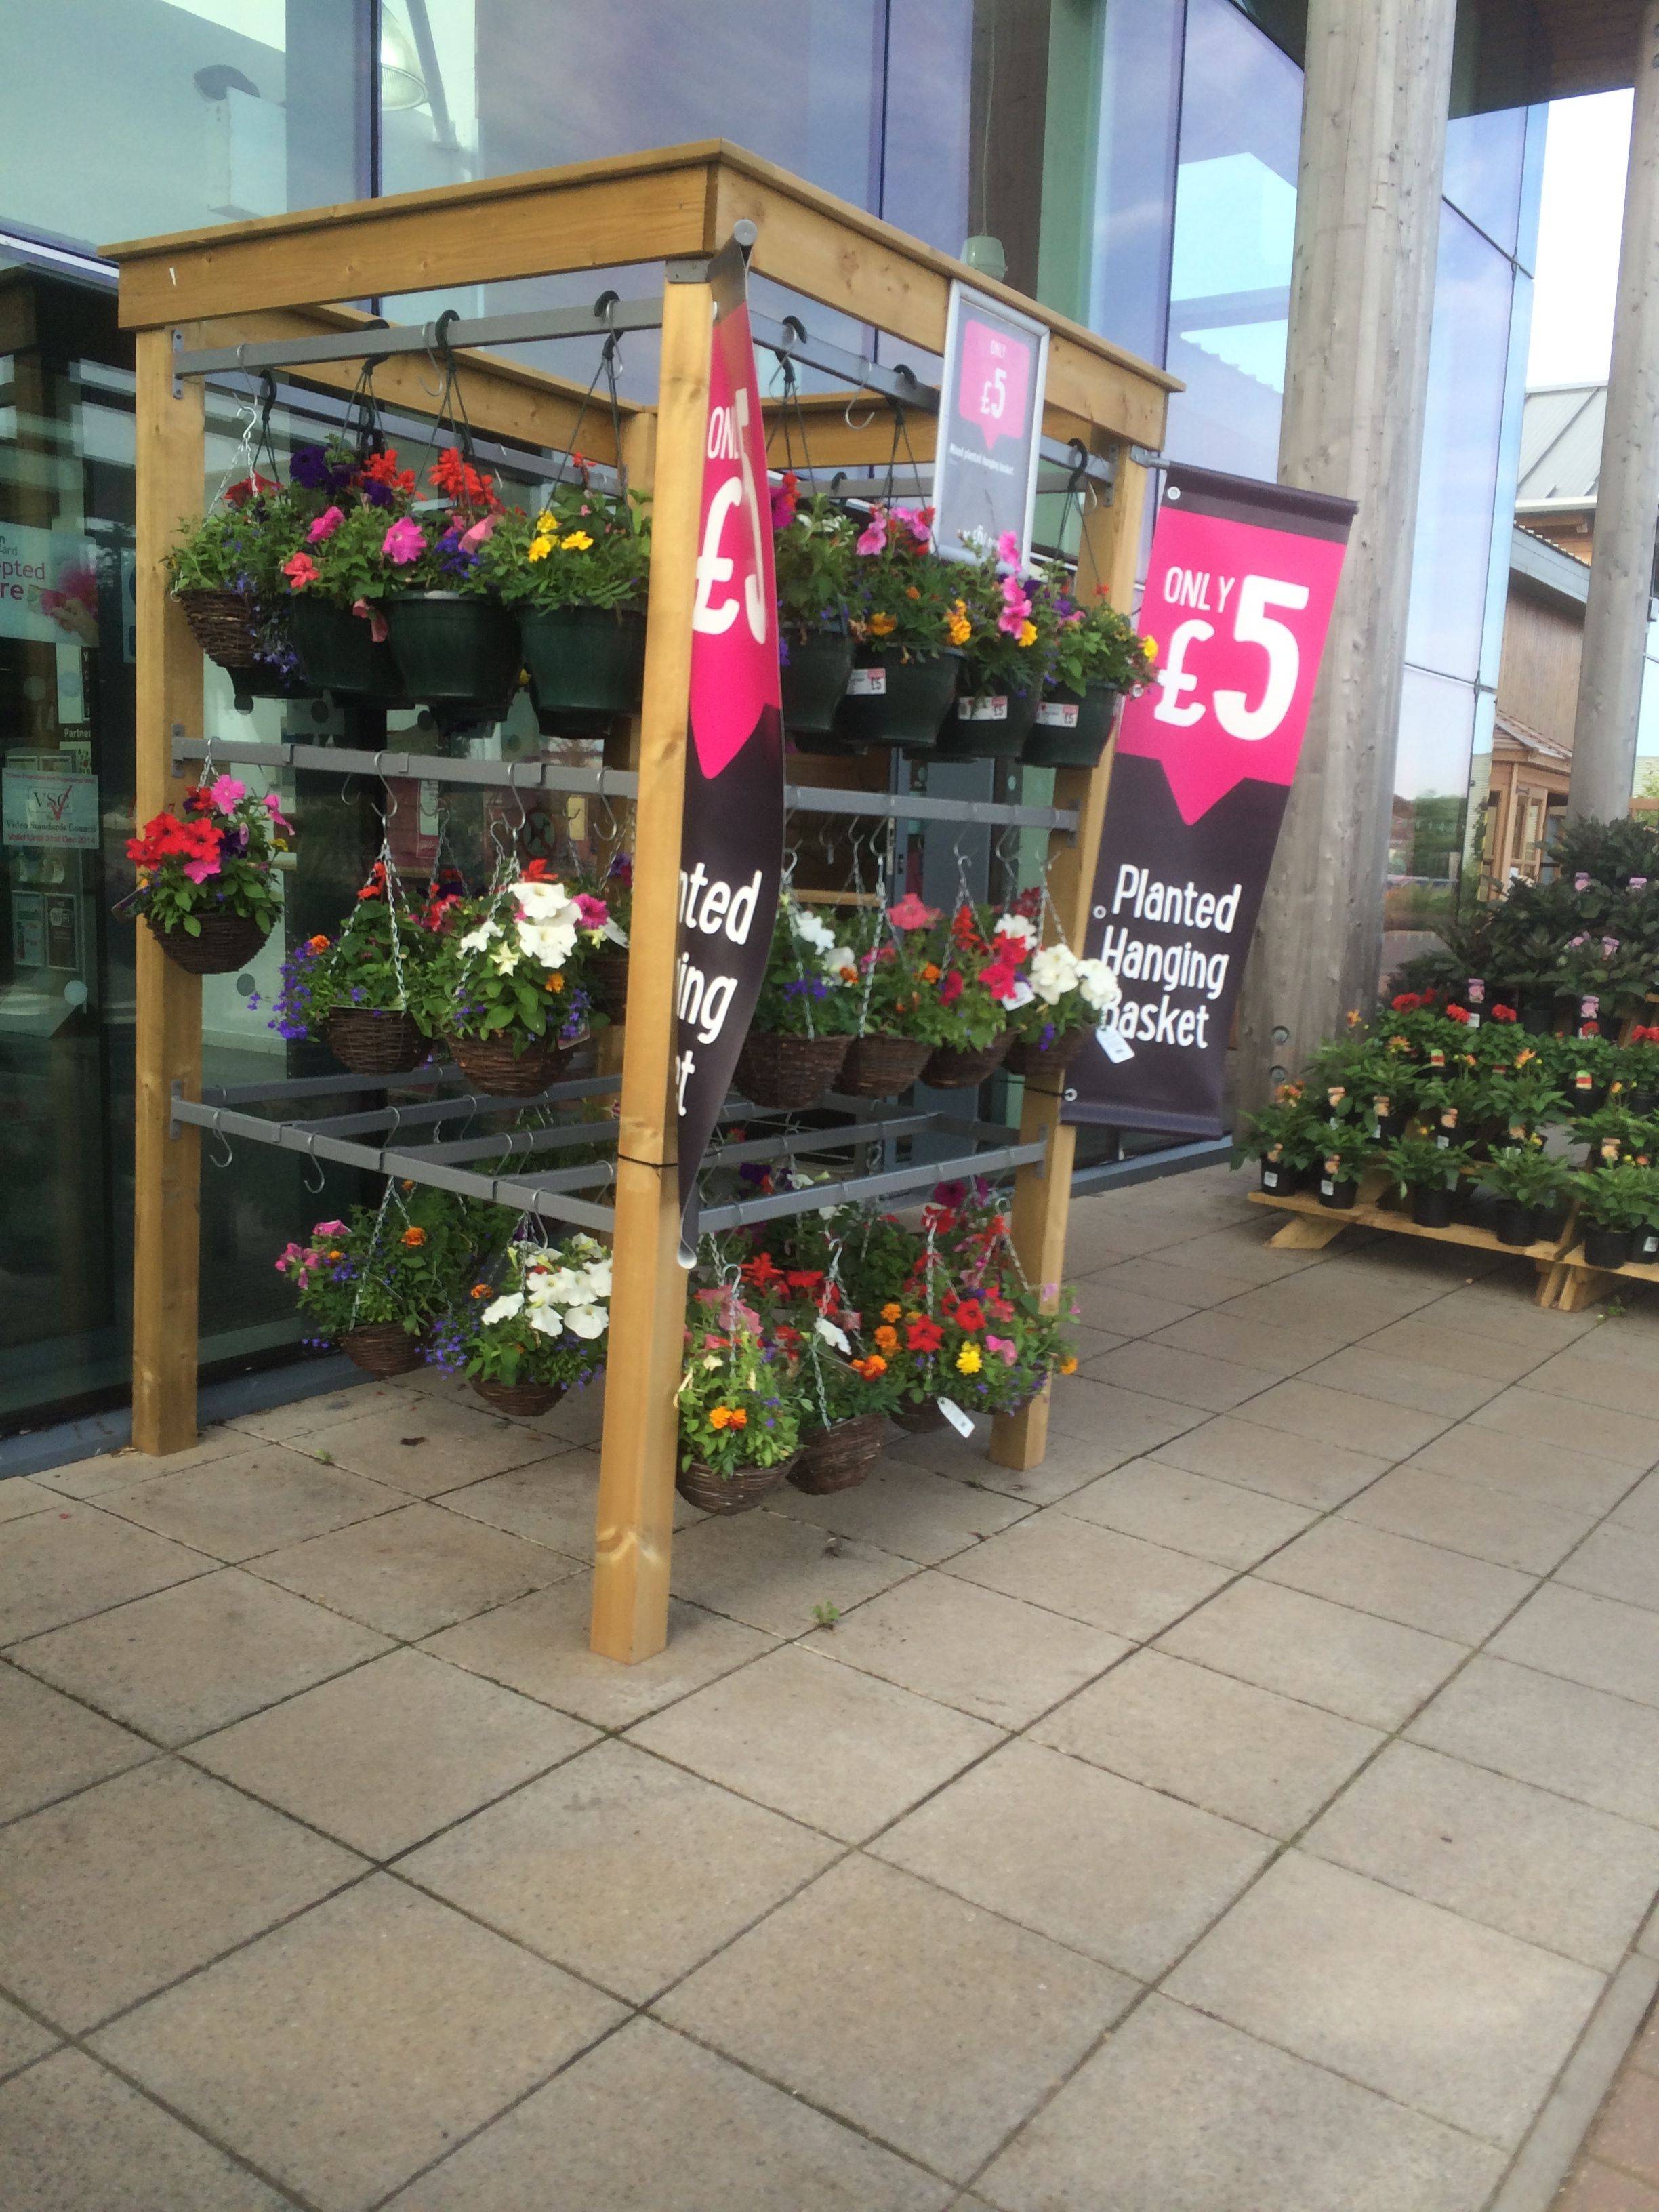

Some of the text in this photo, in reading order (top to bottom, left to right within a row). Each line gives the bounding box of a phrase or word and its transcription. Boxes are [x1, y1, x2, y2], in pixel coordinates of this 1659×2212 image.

[981, 367, 1008, 419] £5
[0, 560, 45, 580] pted
[1164, 566, 1235, 613] ONLY
[1153, 575, 1309, 741] £5
[1112, 863, 1242, 933] Planted
[1100, 924, 1230, 1000] Hanging
